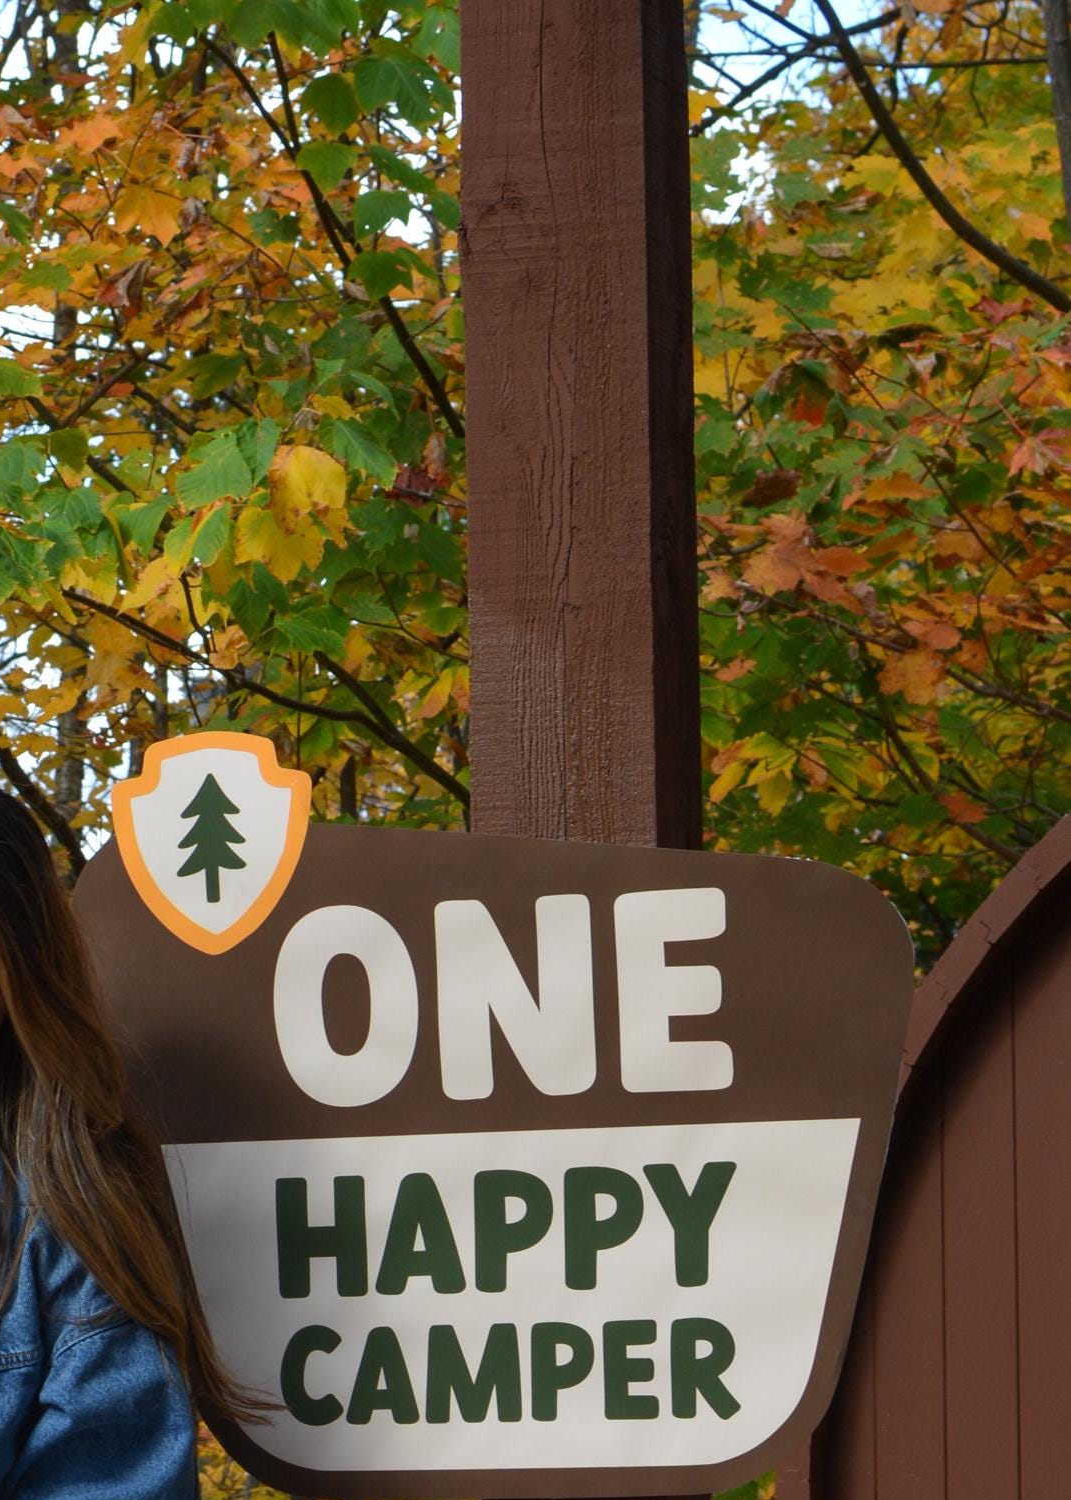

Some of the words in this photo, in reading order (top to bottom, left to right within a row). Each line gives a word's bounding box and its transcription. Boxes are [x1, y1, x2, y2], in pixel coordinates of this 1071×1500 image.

[273, 886, 734, 1108] ONE
[274, 1160, 737, 1299] HAPPY
[280, 1317, 741, 1426] CAMPER
